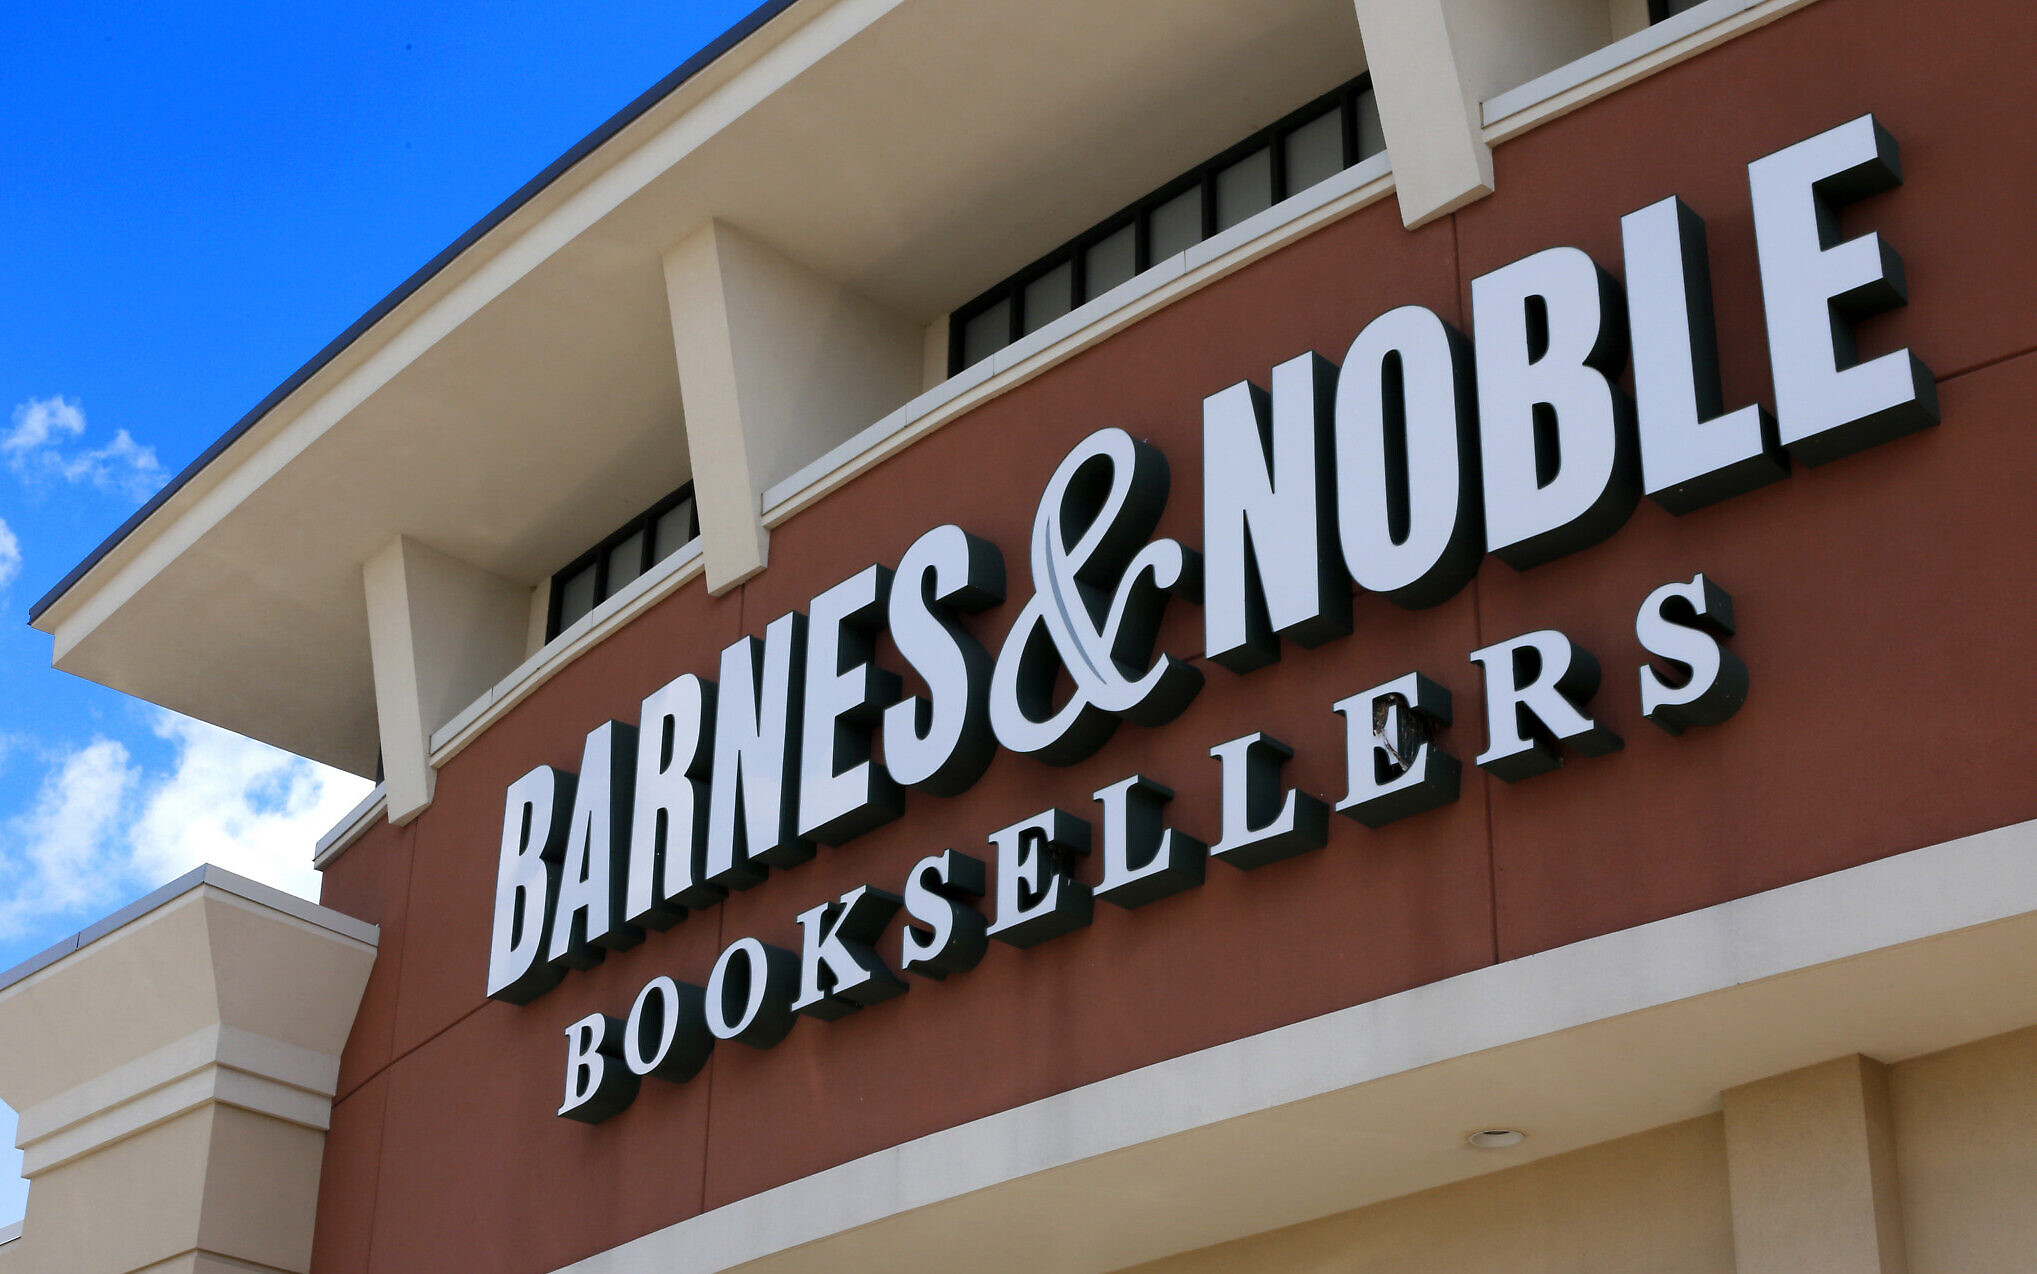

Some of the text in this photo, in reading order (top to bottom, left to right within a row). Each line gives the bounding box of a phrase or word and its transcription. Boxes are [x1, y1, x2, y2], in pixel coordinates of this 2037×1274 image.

[486, 113, 1916, 997] BARNES & NOBLE
[557, 573, 1724, 1117] BOOKSELLERS
